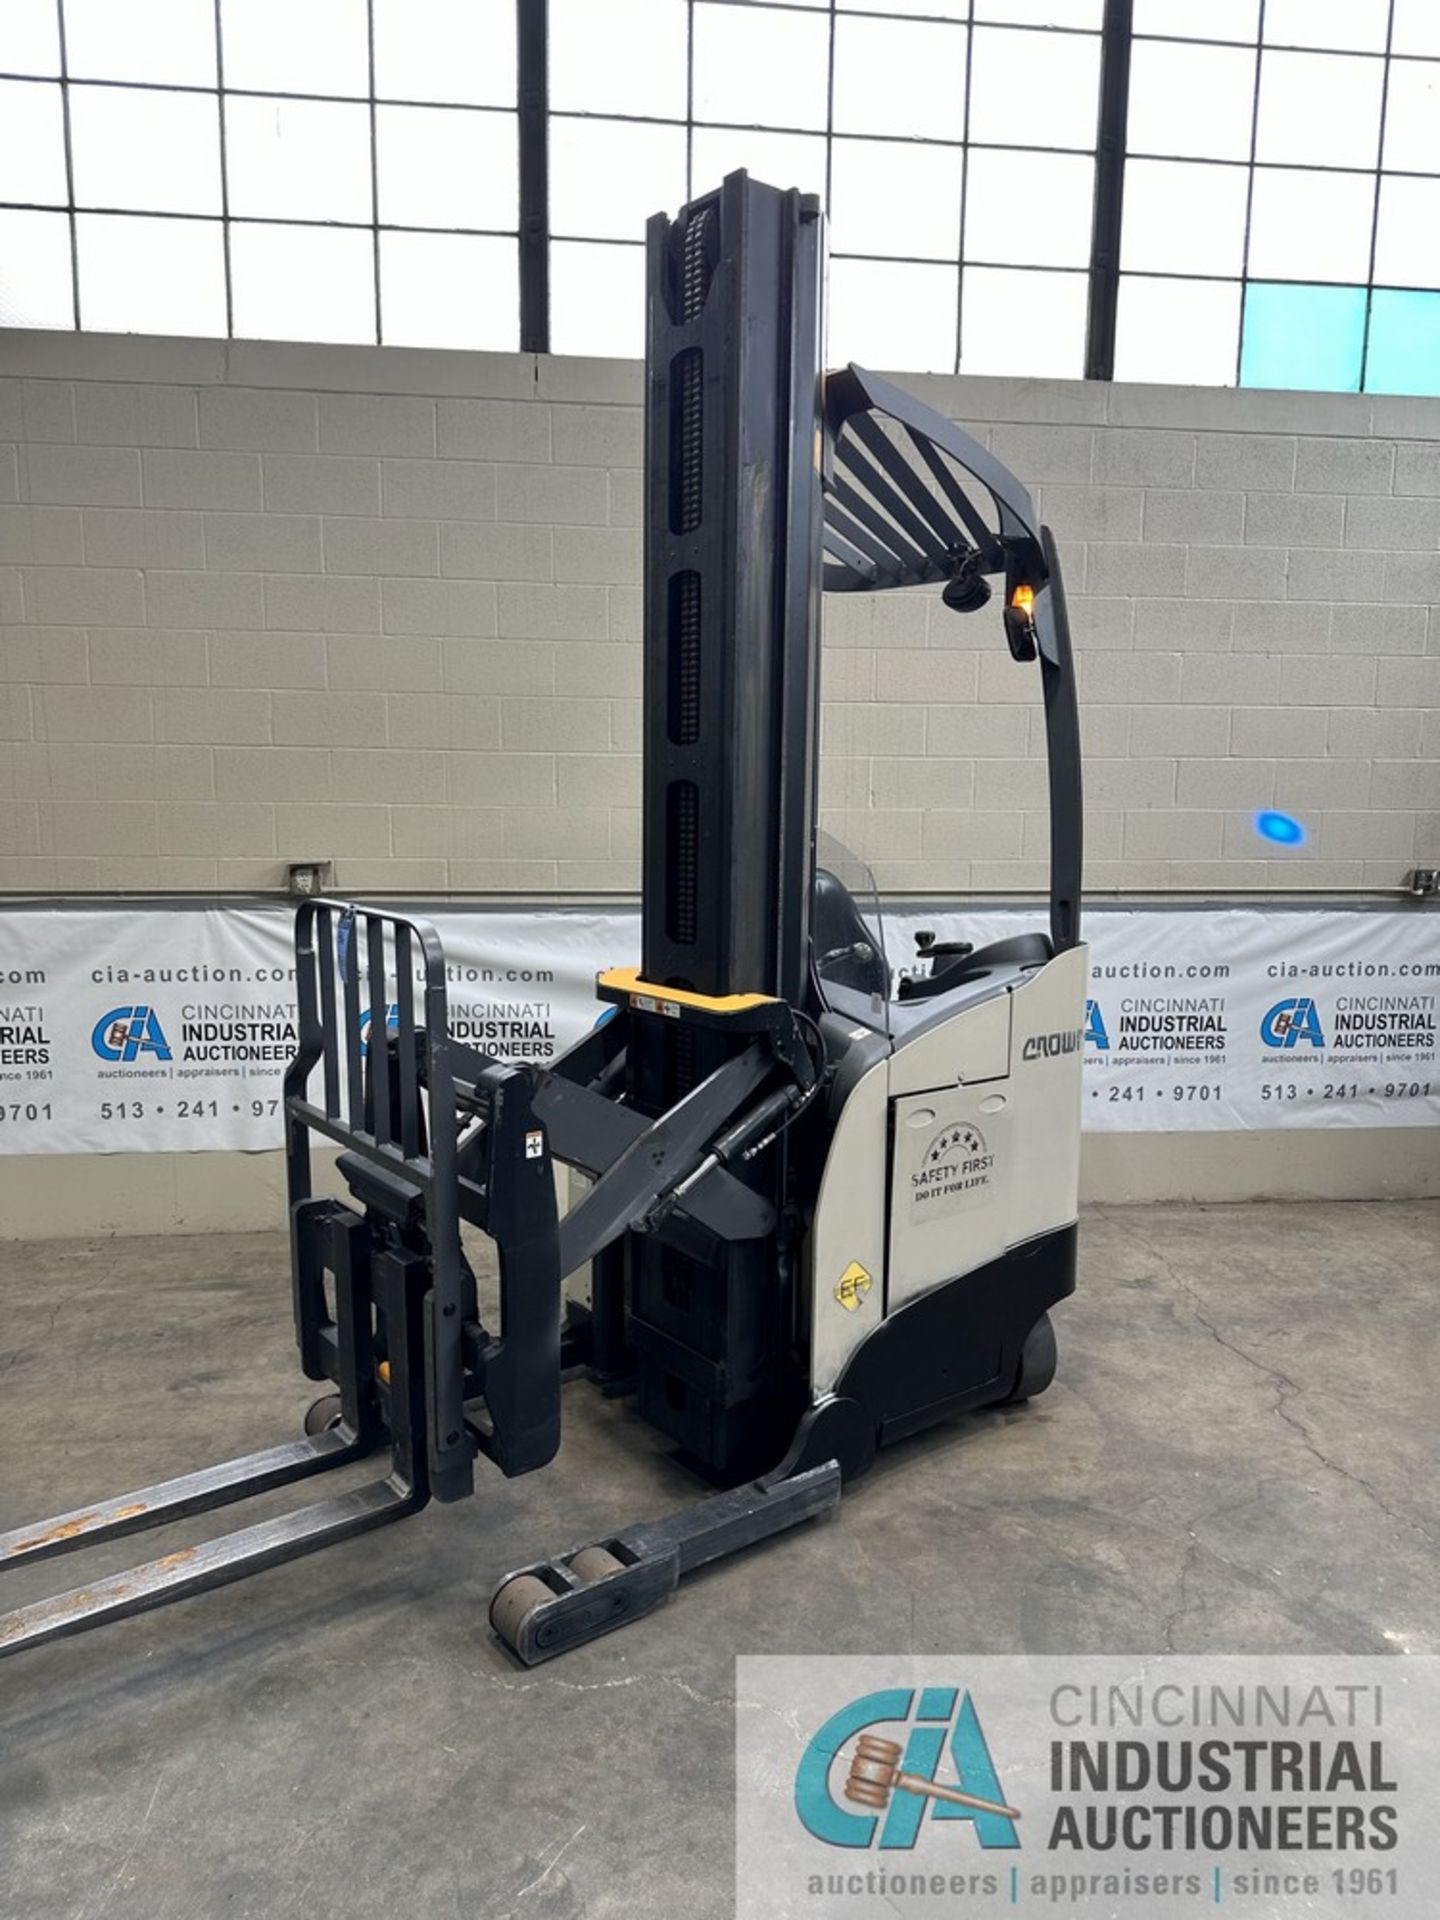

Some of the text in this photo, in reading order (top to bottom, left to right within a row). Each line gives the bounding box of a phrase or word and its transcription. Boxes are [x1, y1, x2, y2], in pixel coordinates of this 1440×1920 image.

[1267, 961, 1440, 978] cia-auction.com
[181, 1003, 298, 1020] CINCINNAT
[1120, 998, 1225, 1013] CINCINNATI
[1335, 996, 1435, 1012] CINCINNATI
[1120, 1015, 1227, 1032] INDUSTRIAL
[1334, 1013, 1437, 1031] INDUSTRIAL
[182, 1023, 297, 1042] INDUSTRIA
[1119, 1035, 1226, 1051] AUCTIONEERS
[1333, 1033, 1436, 1049] AUCTIONEERS
[183, 1045, 297, 1061] AUCTIONEER
[1112, 1055, 1166, 1067] appraisers
[1174, 1055, 1201, 1065] since
[1204, 1055, 1227, 1064] 1961
[1261, 1052, 1436, 1065] auctioneers appraisers since 1961
[97, 1068, 167, 1079] auctioneers
[177, 1067, 240, 1080] appraisers
[1109, 1086, 1221, 1102] 241 9701
[1261, 1082, 1432, 1101] 513 241 9701
[101, 1101, 145, 1119] 513
[177, 1100, 219, 1118] 241
[911, 1154, 995, 1187] SAFETY FIRST
